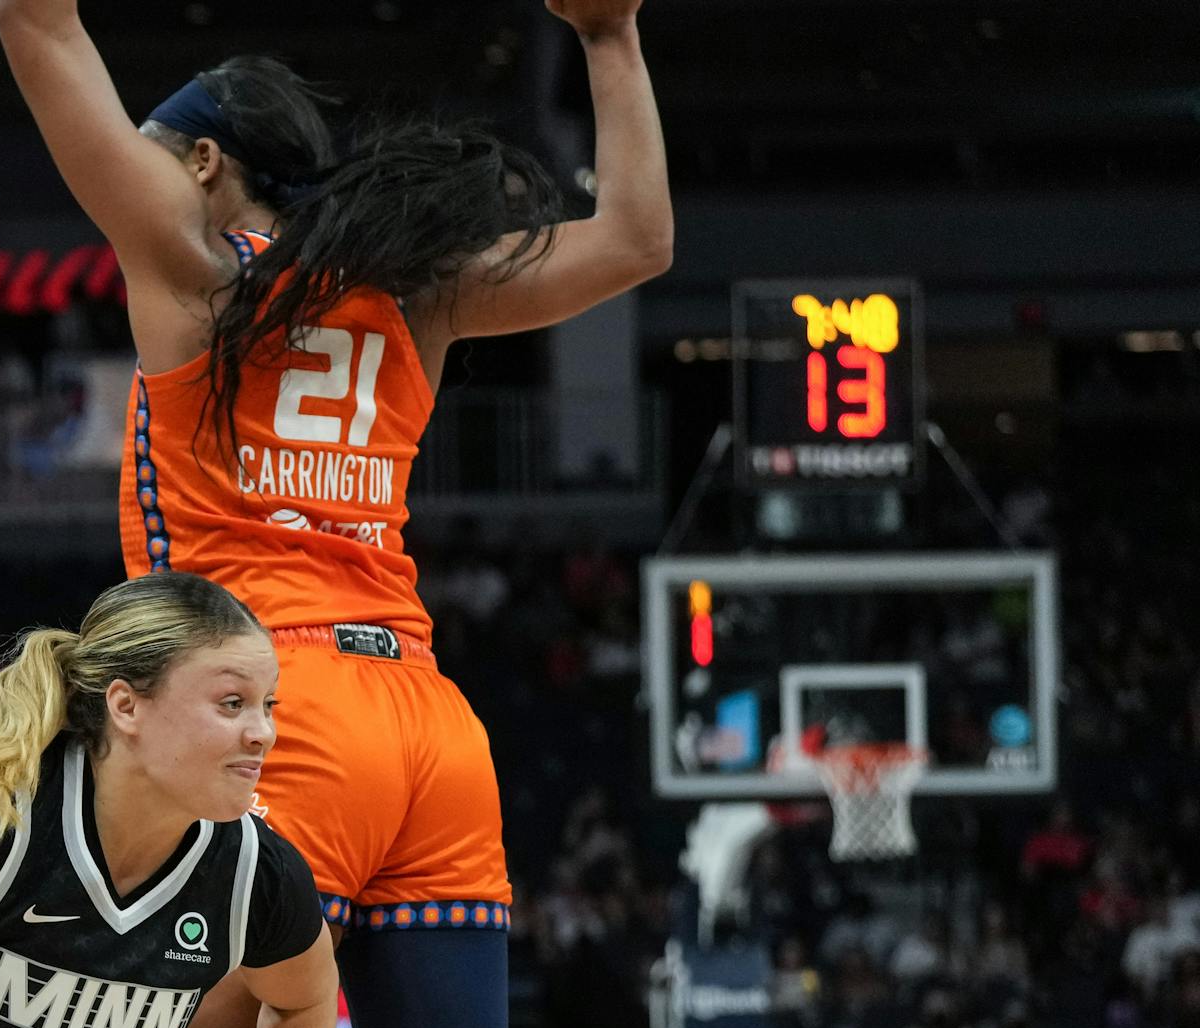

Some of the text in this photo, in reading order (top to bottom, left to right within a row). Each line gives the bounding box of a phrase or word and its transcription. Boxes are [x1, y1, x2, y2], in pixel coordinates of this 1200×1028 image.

[273, 325, 386, 447] 21
[807, 346, 886, 438] 13
[237, 444, 394, 505] CARRINGTON
[163, 949, 212, 964] sharecare
